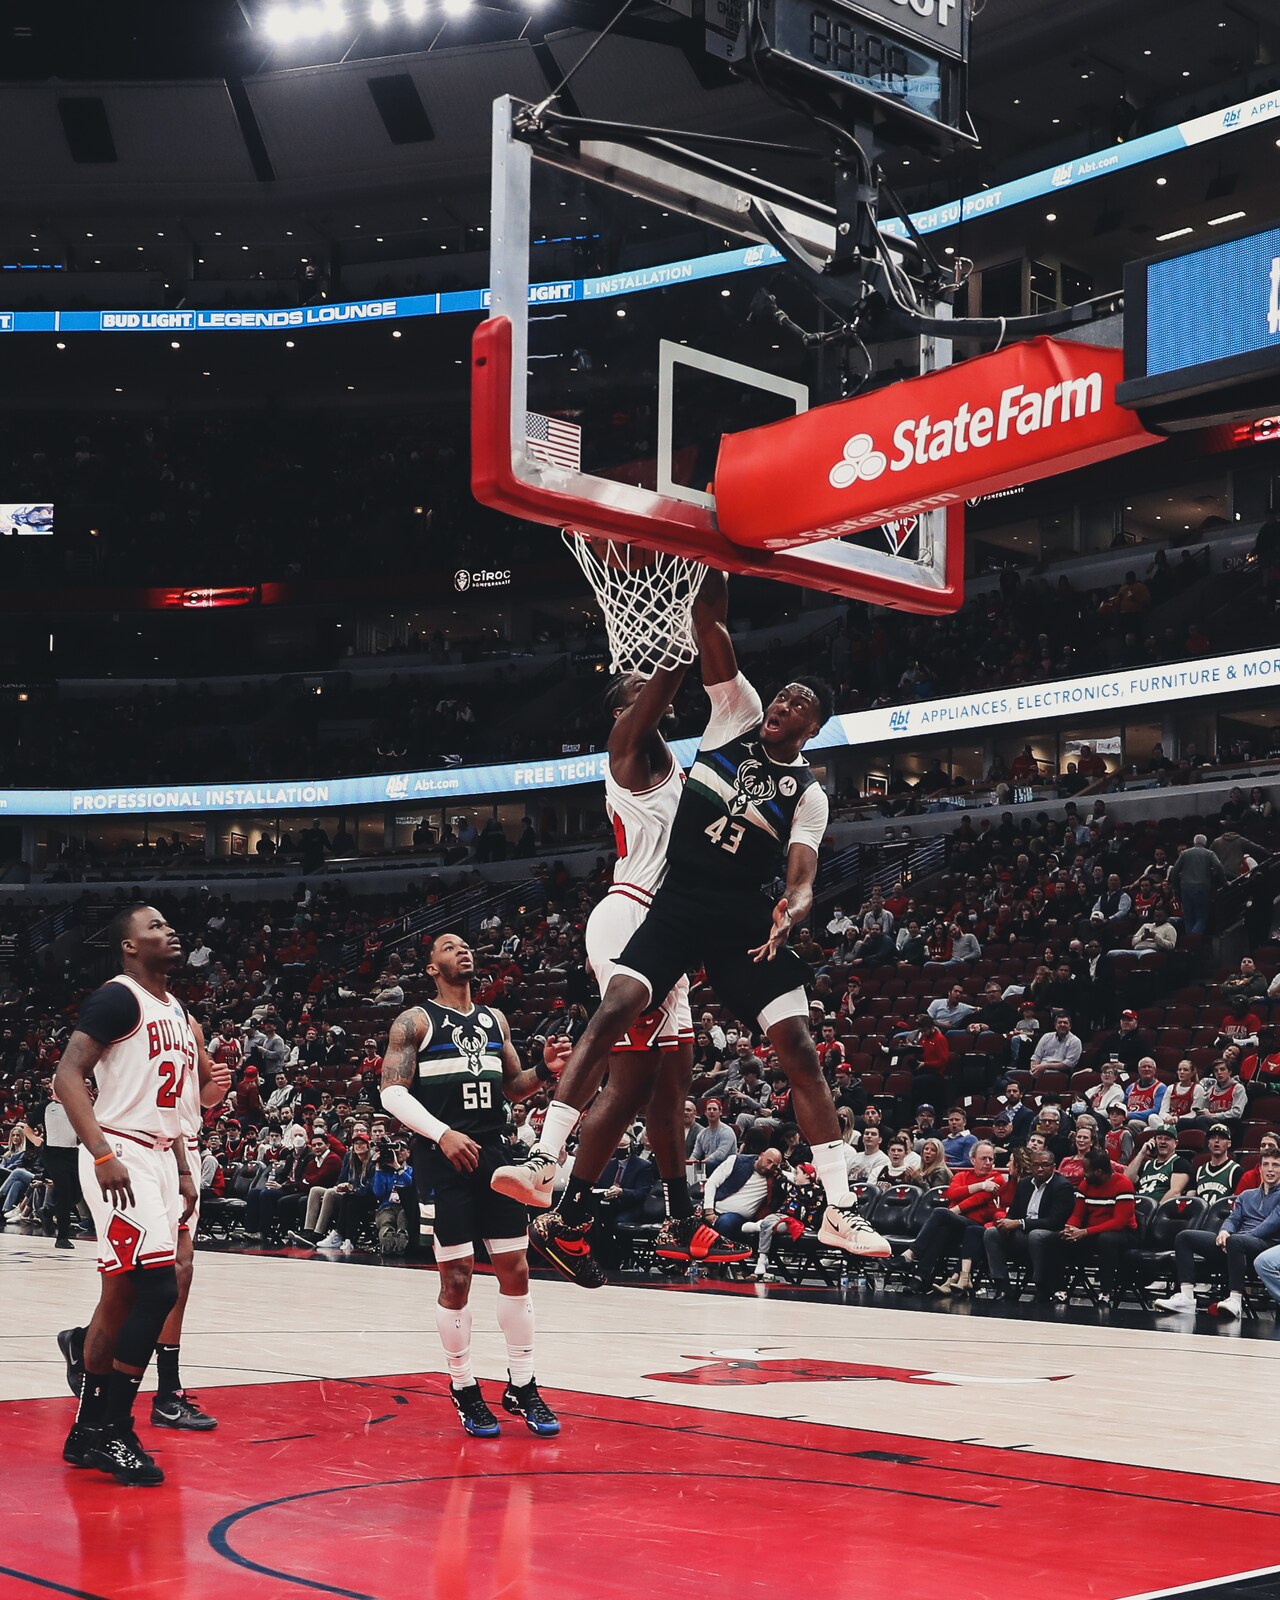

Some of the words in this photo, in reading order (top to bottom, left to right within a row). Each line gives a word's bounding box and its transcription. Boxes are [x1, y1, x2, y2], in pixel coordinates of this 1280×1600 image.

[1222, 109, 1242, 128] Abt
[899, 212, 938, 235] TCH
[1051, 163, 1074, 187] Abt
[1077, 154, 1119, 176] Abt.com
[528, 284, 572, 301] IGHT
[595, 264, 693, 295] INSTALLATION
[103, 314, 140, 328] BUD
[142, 313, 192, 328] LIGHT
[197, 310, 303, 327] LEGENDS
[306, 302, 397, 324] LOUNGE
[889, 711, 911, 731] Abt
[920, 697, 1013, 725] APPLIANCES,
[1017, 682, 1124, 711] ELECTRONICS,
[1130, 667, 1221, 694] FURNITURE
[1226, 665, 1237, 679] &
[514, 768, 554, 786] FREE
[558, 761, 596, 781] TECH
[72, 790, 201, 811] PROFESSIONAL
[205, 786, 329, 806] INSTALLATION
[385, 774, 409, 799] Abt
[413, 777, 459, 792] Abt.com
[704, 815, 746, 854] 43
[462, 1081, 492, 1110] 59
